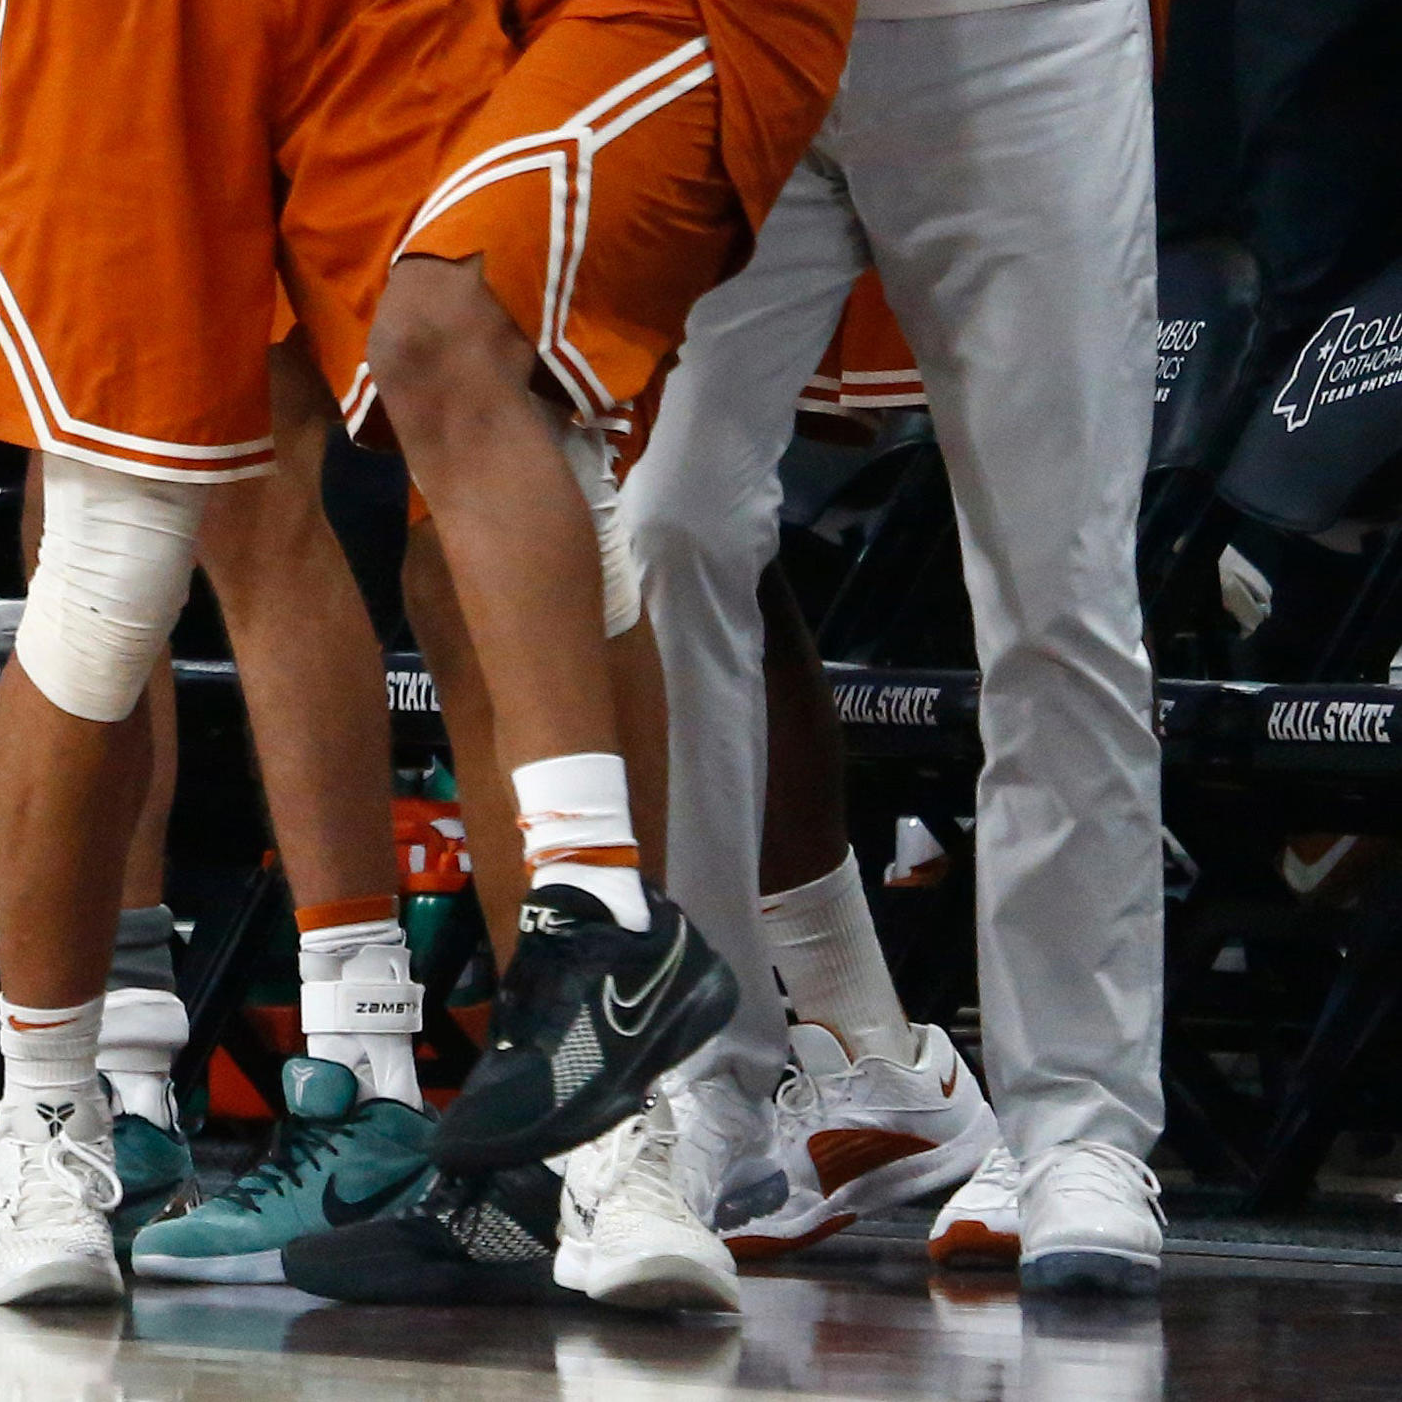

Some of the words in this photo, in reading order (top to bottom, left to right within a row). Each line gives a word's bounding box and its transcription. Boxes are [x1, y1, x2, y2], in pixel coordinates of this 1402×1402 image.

[1319, 388, 1356, 406] TEAM
[875, 685, 941, 727] STATE
[1267, 701, 1322, 741] HAIL
[1323, 701, 1395, 743] STATE
